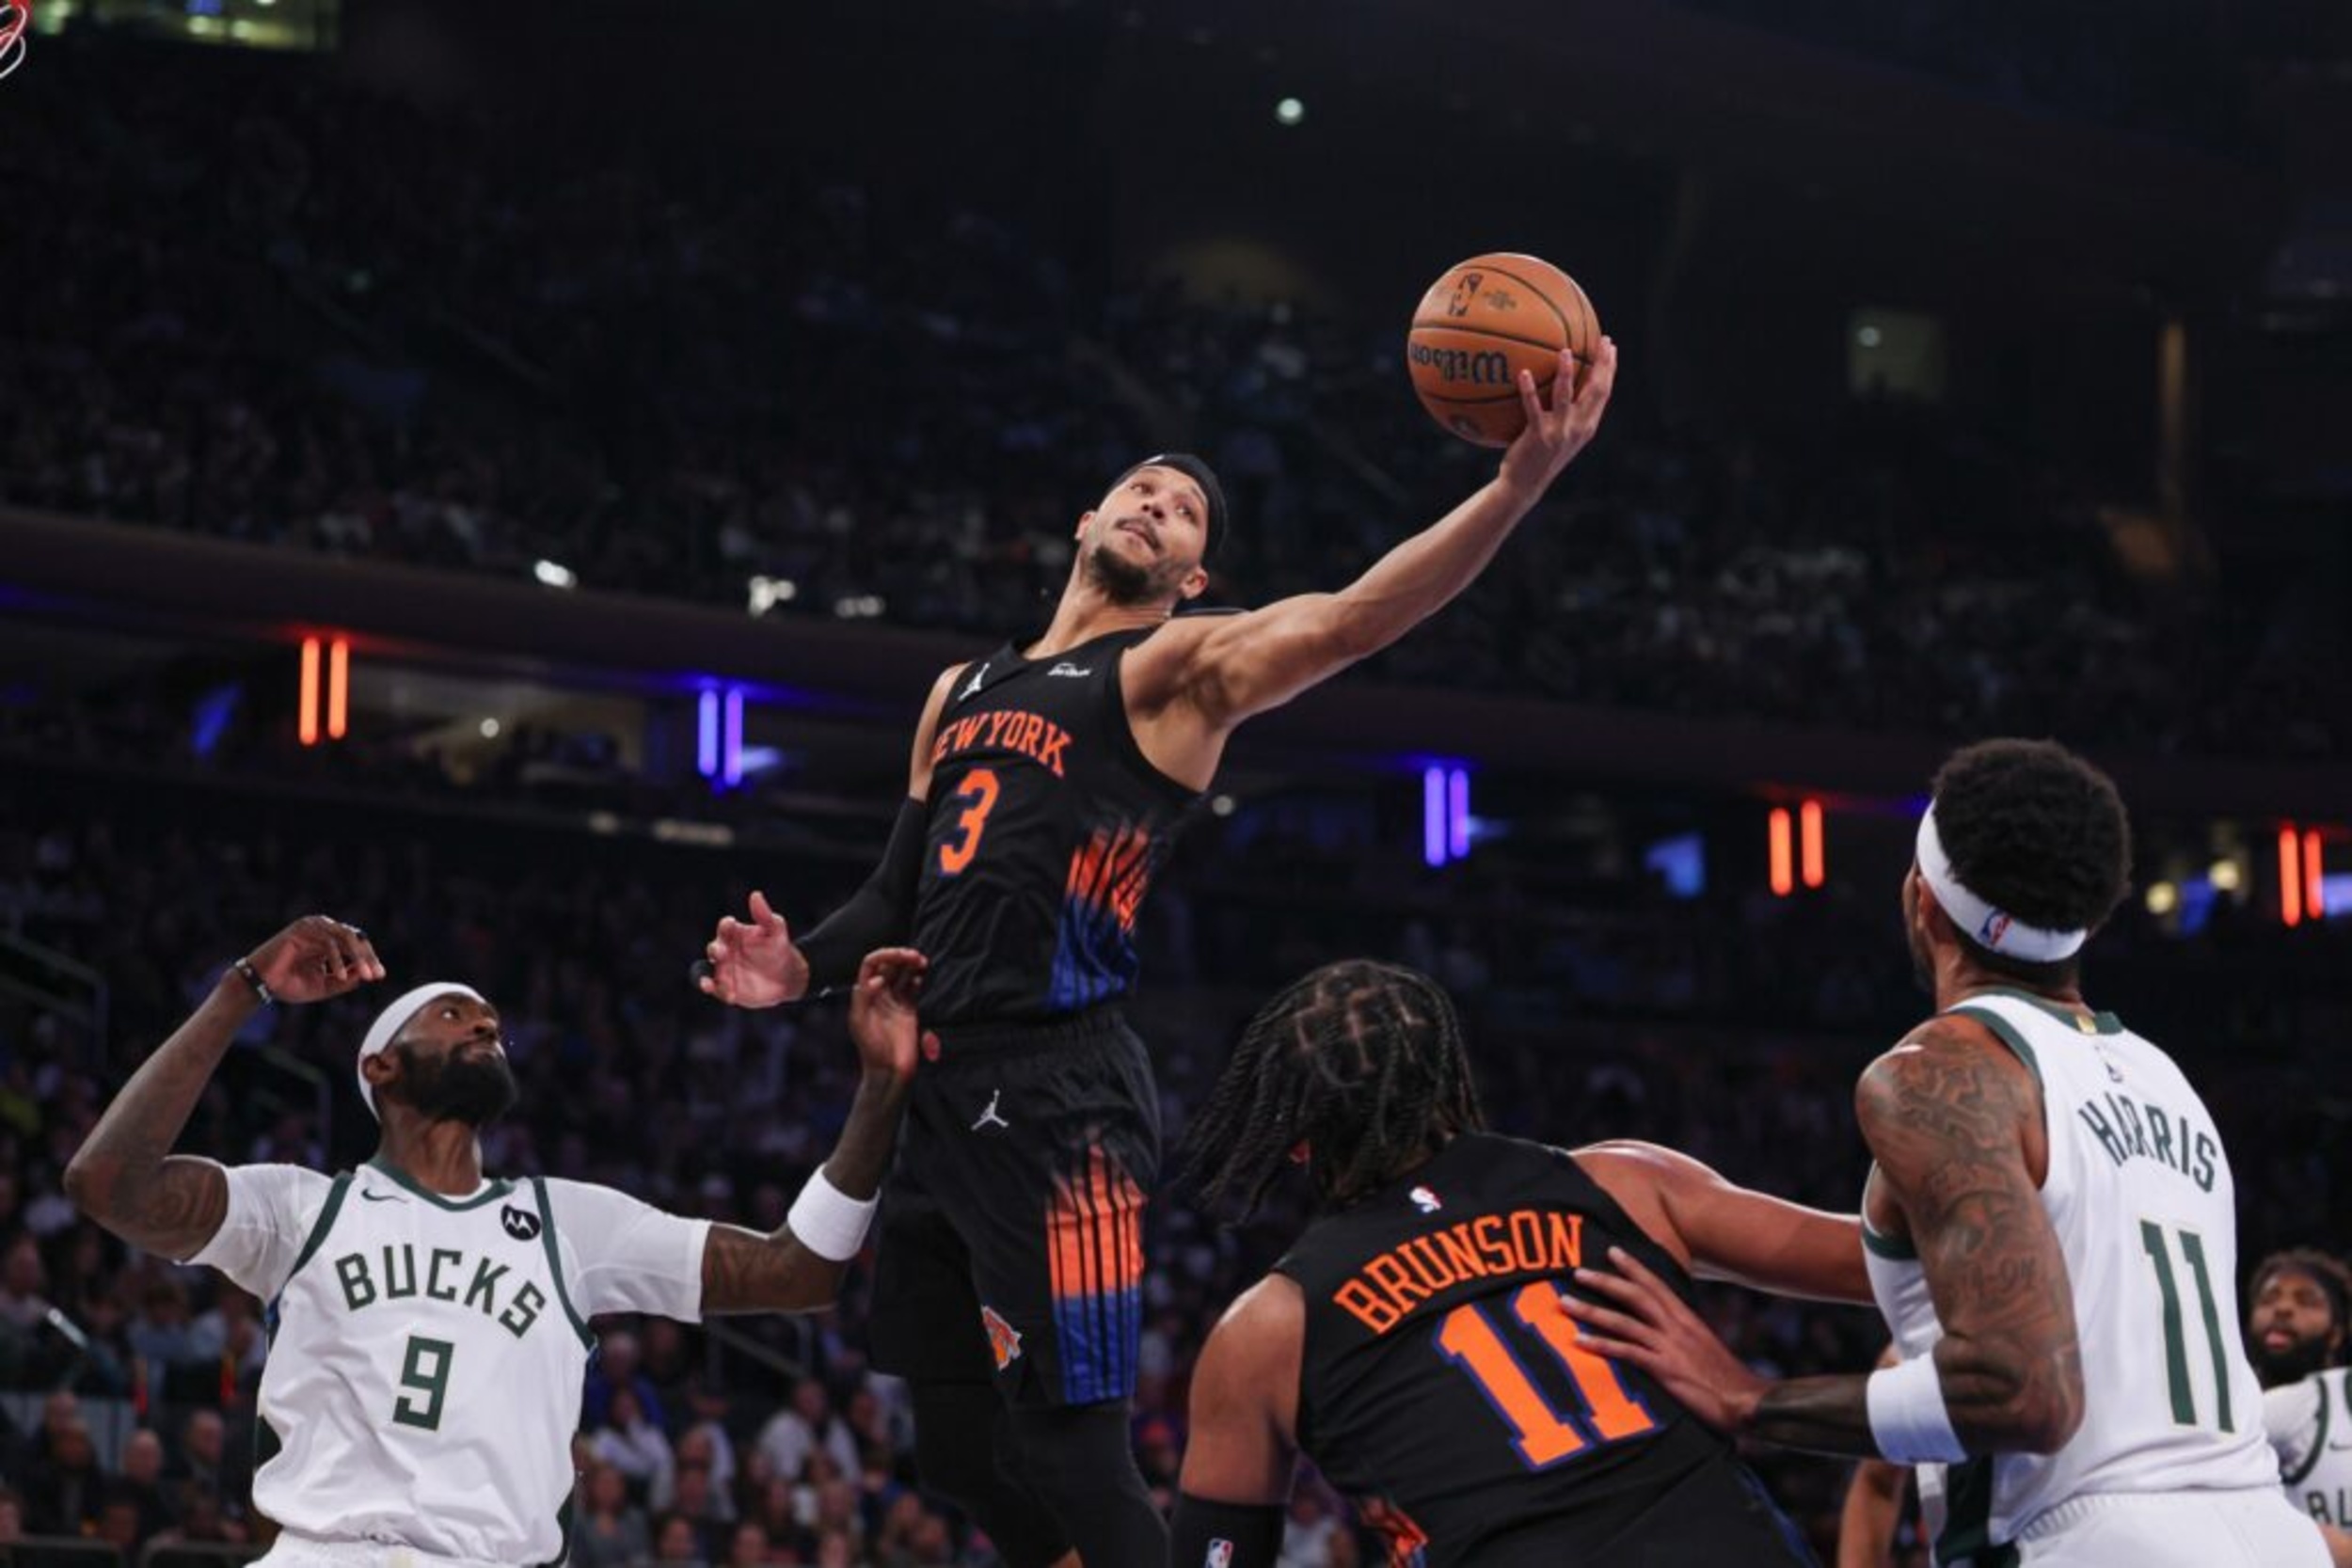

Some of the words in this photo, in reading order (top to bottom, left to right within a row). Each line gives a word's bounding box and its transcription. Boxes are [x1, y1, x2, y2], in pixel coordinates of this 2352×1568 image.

[1411, 342, 1511, 385] Wilson
[931, 713, 990, 764] EW
[985, 710, 1072, 778] YORK
[940, 768, 1000, 874] 3
[2077, 1091, 2217, 1194] HARRIS
[335, 1243, 547, 1338] BUCKS
[1334, 1211, 1583, 1335] BRUNSON
[1434, 1279, 1660, 1471] 11
[2139, 1219, 2236, 1435] 11
[392, 1335, 455, 1431] 9
